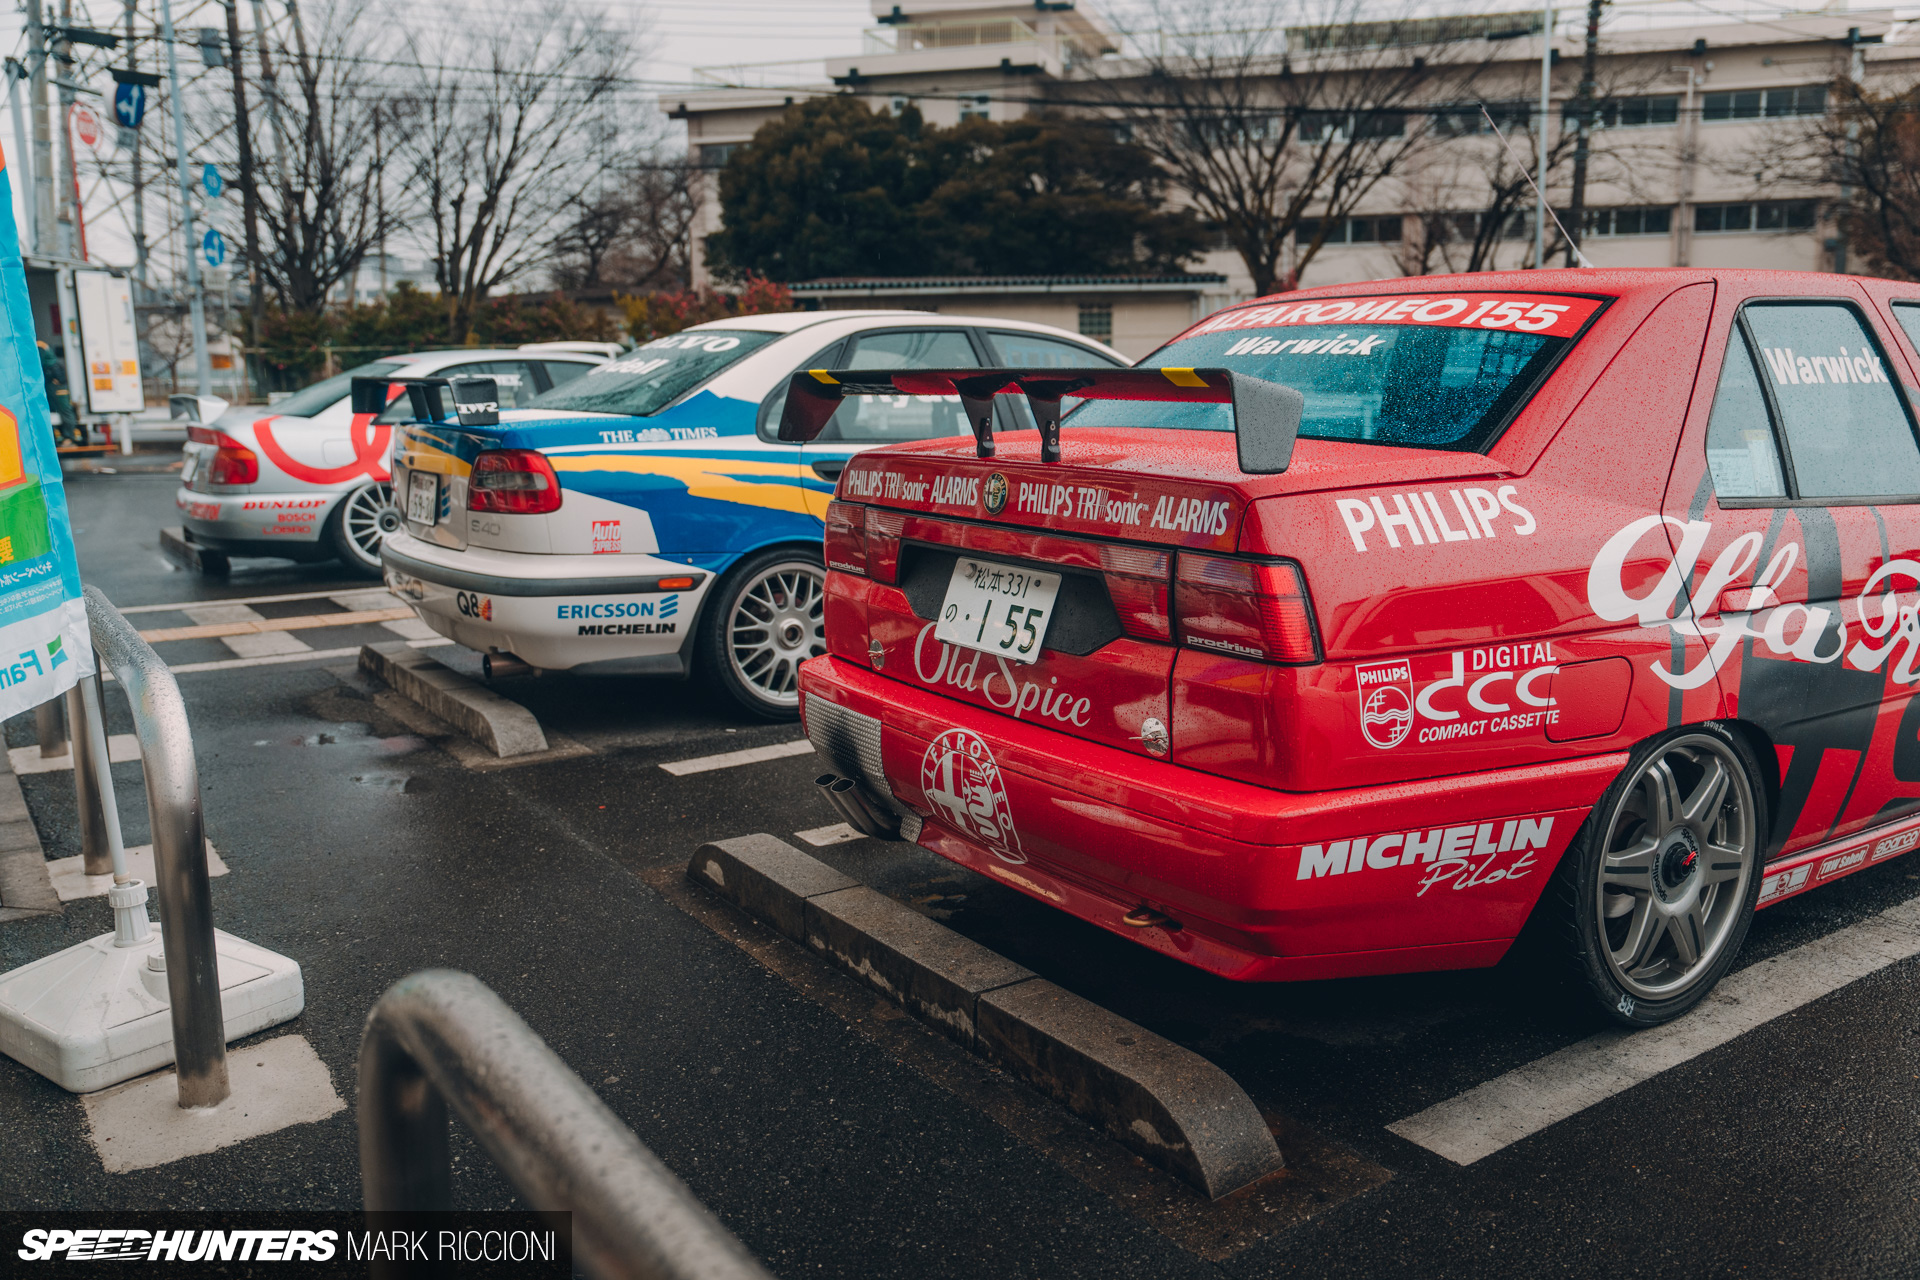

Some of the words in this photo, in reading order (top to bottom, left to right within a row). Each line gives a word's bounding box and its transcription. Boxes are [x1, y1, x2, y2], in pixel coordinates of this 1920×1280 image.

[1275, 298, 1471, 325] ROMEO
[1460, 300, 1571, 331] 155
[1224, 334, 1386, 356] Warwick
[1764, 345, 1889, 385] Warwick
[599, 430, 635, 443] THE
[671, 426, 719, 441] TIMES
[848, 469, 884, 498] PHILIPS
[930, 475, 980, 507] ALARMS
[241, 500, 326, 511] DUNLOP
[1018, 482, 1075, 518] PHILIPS
[1150, 495, 1230, 536] ALARMS
[277, 512, 316, 523] BOSCH
[471, 520, 501, 537] S40
[1335, 485, 1537, 553] PHILIPS
[592, 522, 621, 541] Auto
[593, 540, 621, 552] EXPRESS
[829, 560, 865, 574] prodrive
[457, 591, 481, 618] Q8
[557, 602, 655, 619] ERICSSON
[577, 623, 676, 636] MICHELIN
[1187, 635, 1264, 657] prodrive
[1472, 642, 1557, 671] DIGITAL
[1359, 666, 1409, 686] PHILIPS
[1415, 651, 1561, 721] dcc
[983, 655, 1091, 727] Spice
[1419, 719, 1485, 743] COMPACT
[1490, 709, 1560, 736] CASSETTE
[1296, 817, 1555, 881] MICHELIN
[1876, 830, 1919, 854] sparco
[1416, 850, 1538, 897] Pilot
[1821, 857, 1843, 875] TRW
